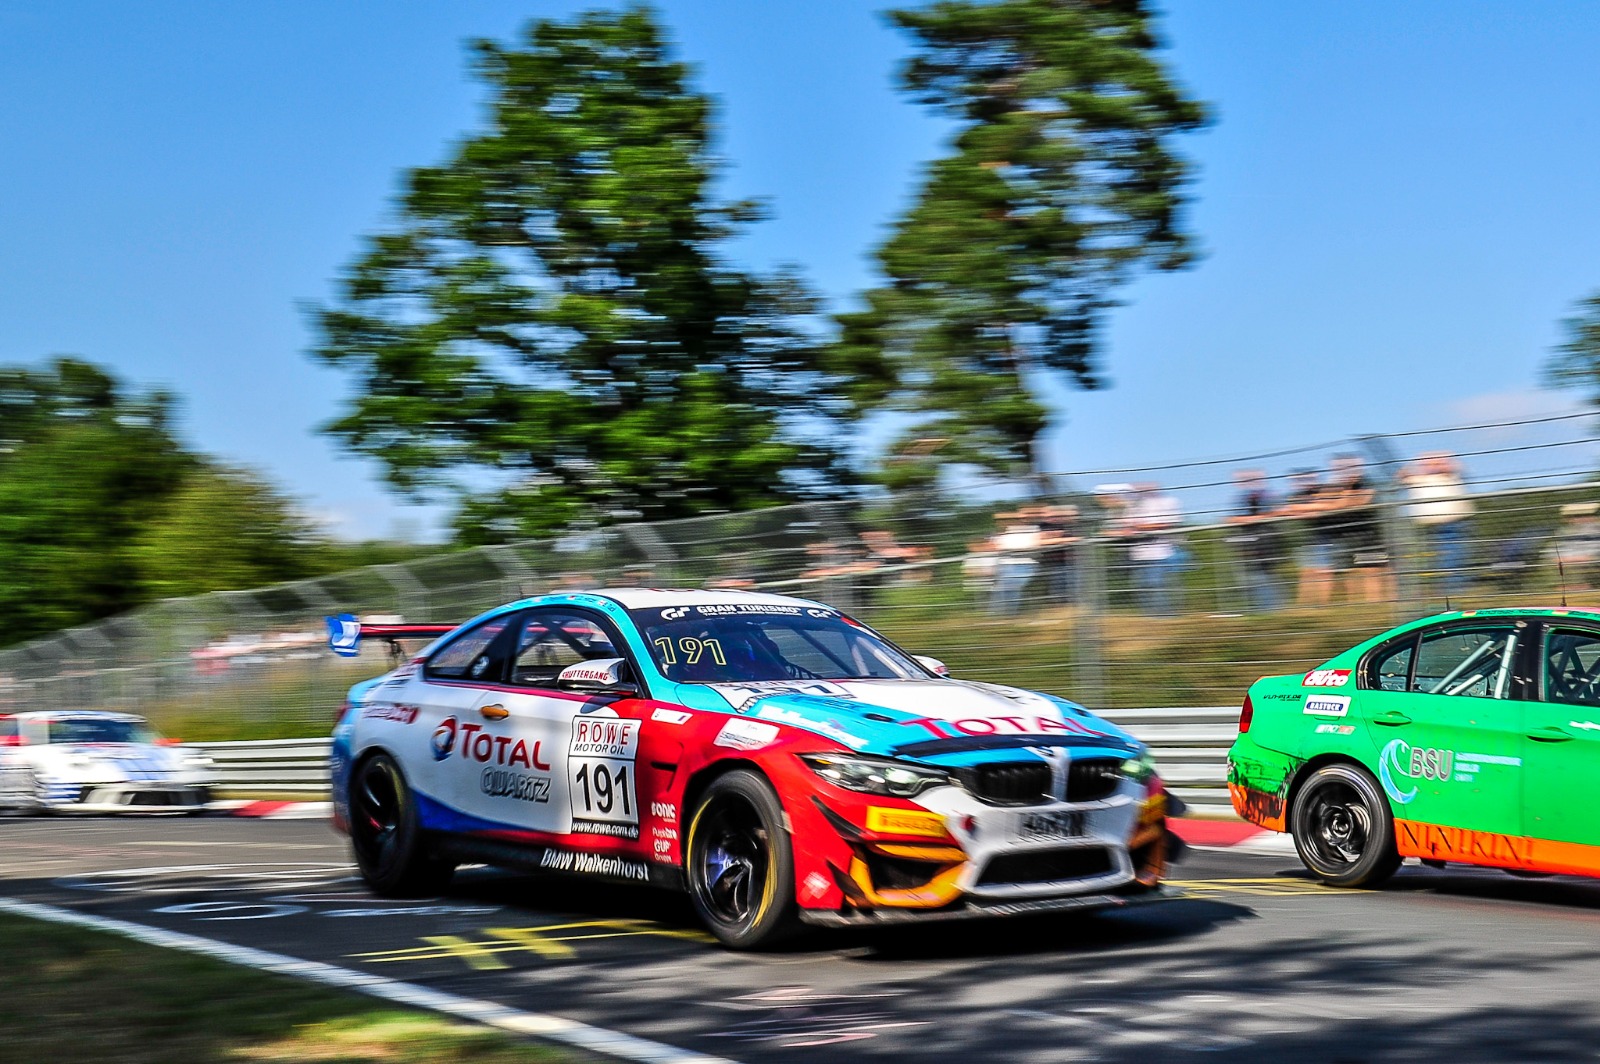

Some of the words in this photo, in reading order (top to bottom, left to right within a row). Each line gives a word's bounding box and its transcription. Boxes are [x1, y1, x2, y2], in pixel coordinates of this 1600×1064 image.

[696, 605, 737, 614] GRAN
[737, 604, 799, 614] TURISMO
[654, 637, 727, 665] 191
[577, 721, 632, 746] ROWE
[900, 716, 1109, 739] TOTAL
[460, 723, 551, 772] TOTAL
[574, 743, 608, 753] MOTOR
[610, 744, 625, 755] OIL
[1409, 746, 1454, 782] BSU
[481, 766, 552, 803] QUARTZ
[576, 763, 631, 816] 191
[540, 848, 574, 870] BMW
[574, 852, 650, 881] Walkenhorst
